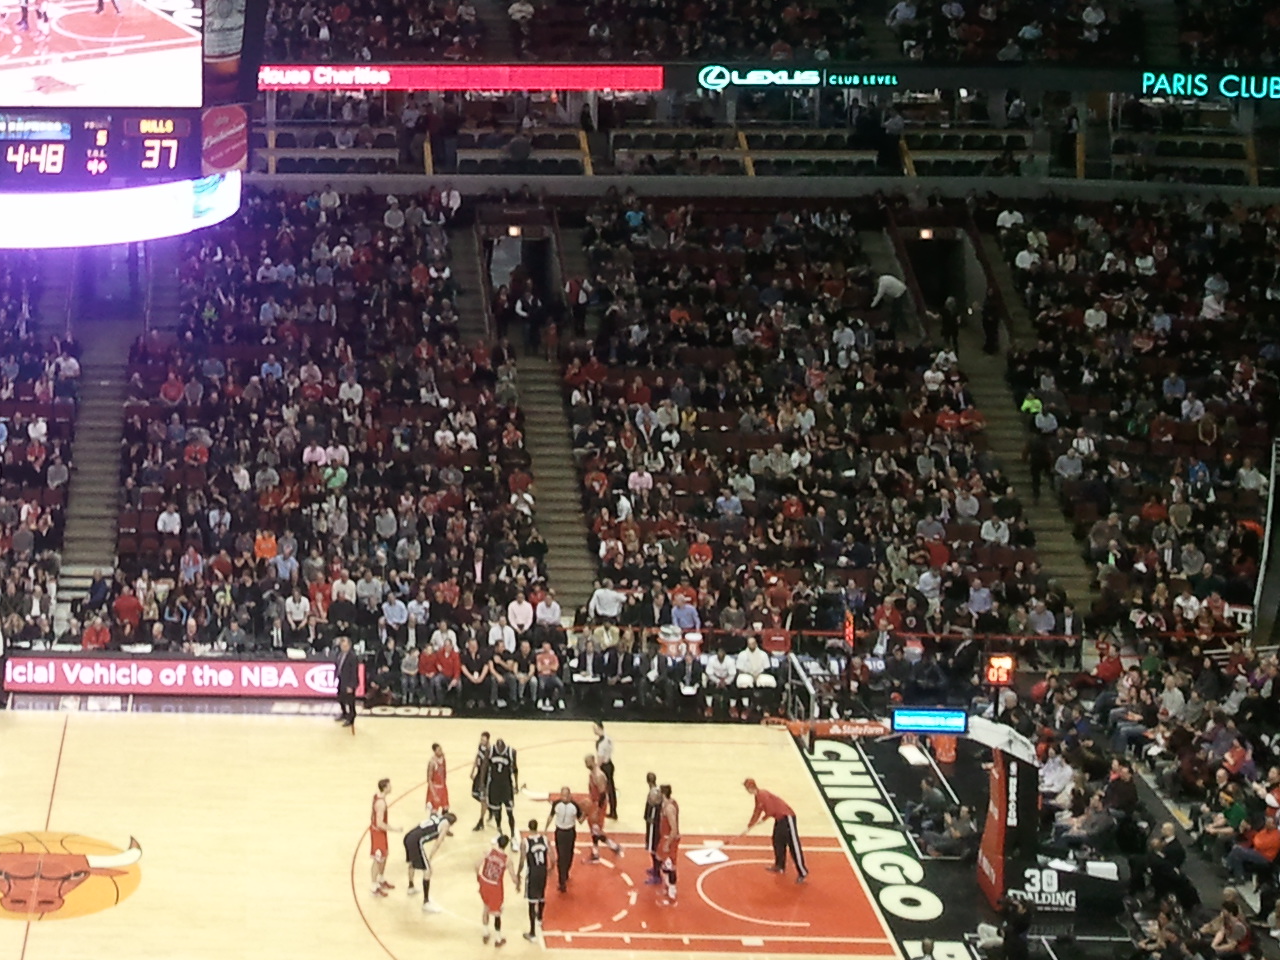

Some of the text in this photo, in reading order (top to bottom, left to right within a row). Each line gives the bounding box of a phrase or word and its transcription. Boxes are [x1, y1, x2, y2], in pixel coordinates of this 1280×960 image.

[313, 66, 391, 86] Charities
[731, 69, 898, 86] LEXUS CLUB LEVEL
[1142, 72, 1280, 99] PARIS CLUB
[6, 143, 65, 174] 4:48
[141, 139, 178, 169] 37
[62, 662, 153, 686] Vehicle
[159, 663, 187, 686] of
[192, 664, 234, 687] the
[241, 666, 298, 688] NBA
[804, 740, 944, 921] CHICAGO
[1024, 868, 1058, 892] 30
